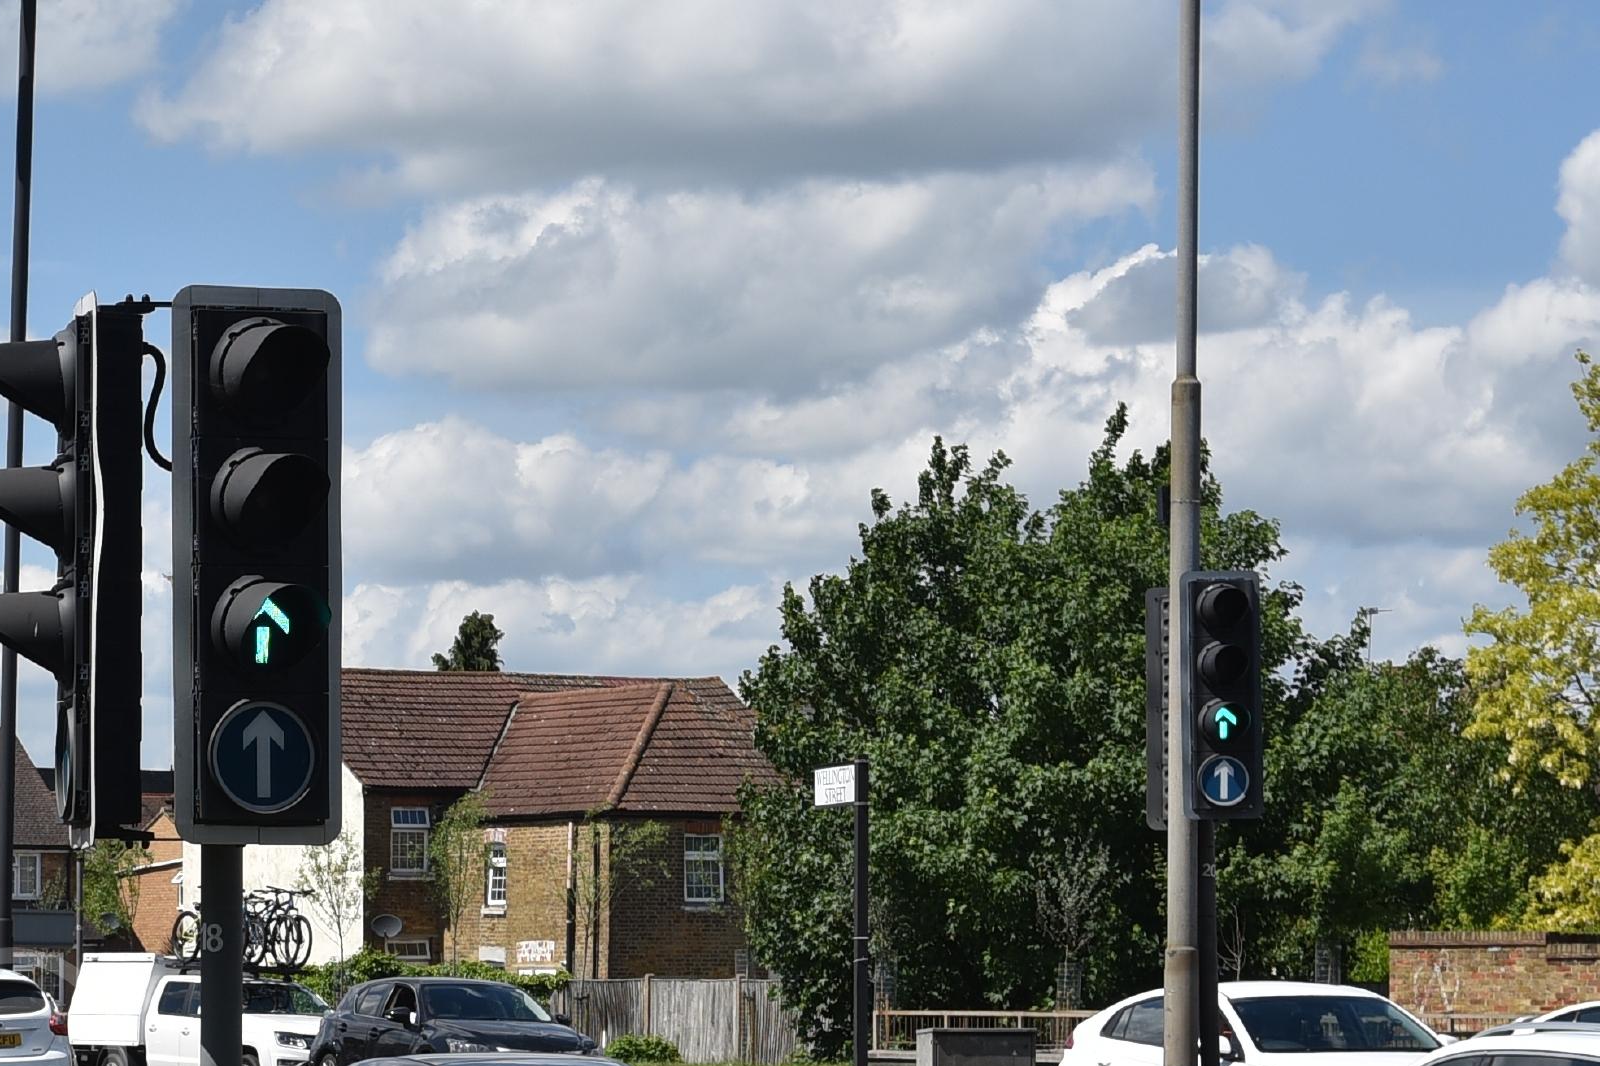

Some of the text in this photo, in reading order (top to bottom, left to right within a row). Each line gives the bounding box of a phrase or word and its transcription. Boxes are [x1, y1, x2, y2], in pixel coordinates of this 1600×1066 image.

[816, 766, 855, 785] WELLINGTON
[824, 786, 846, 803] STREET
[200, 922, 224, 953] 18
